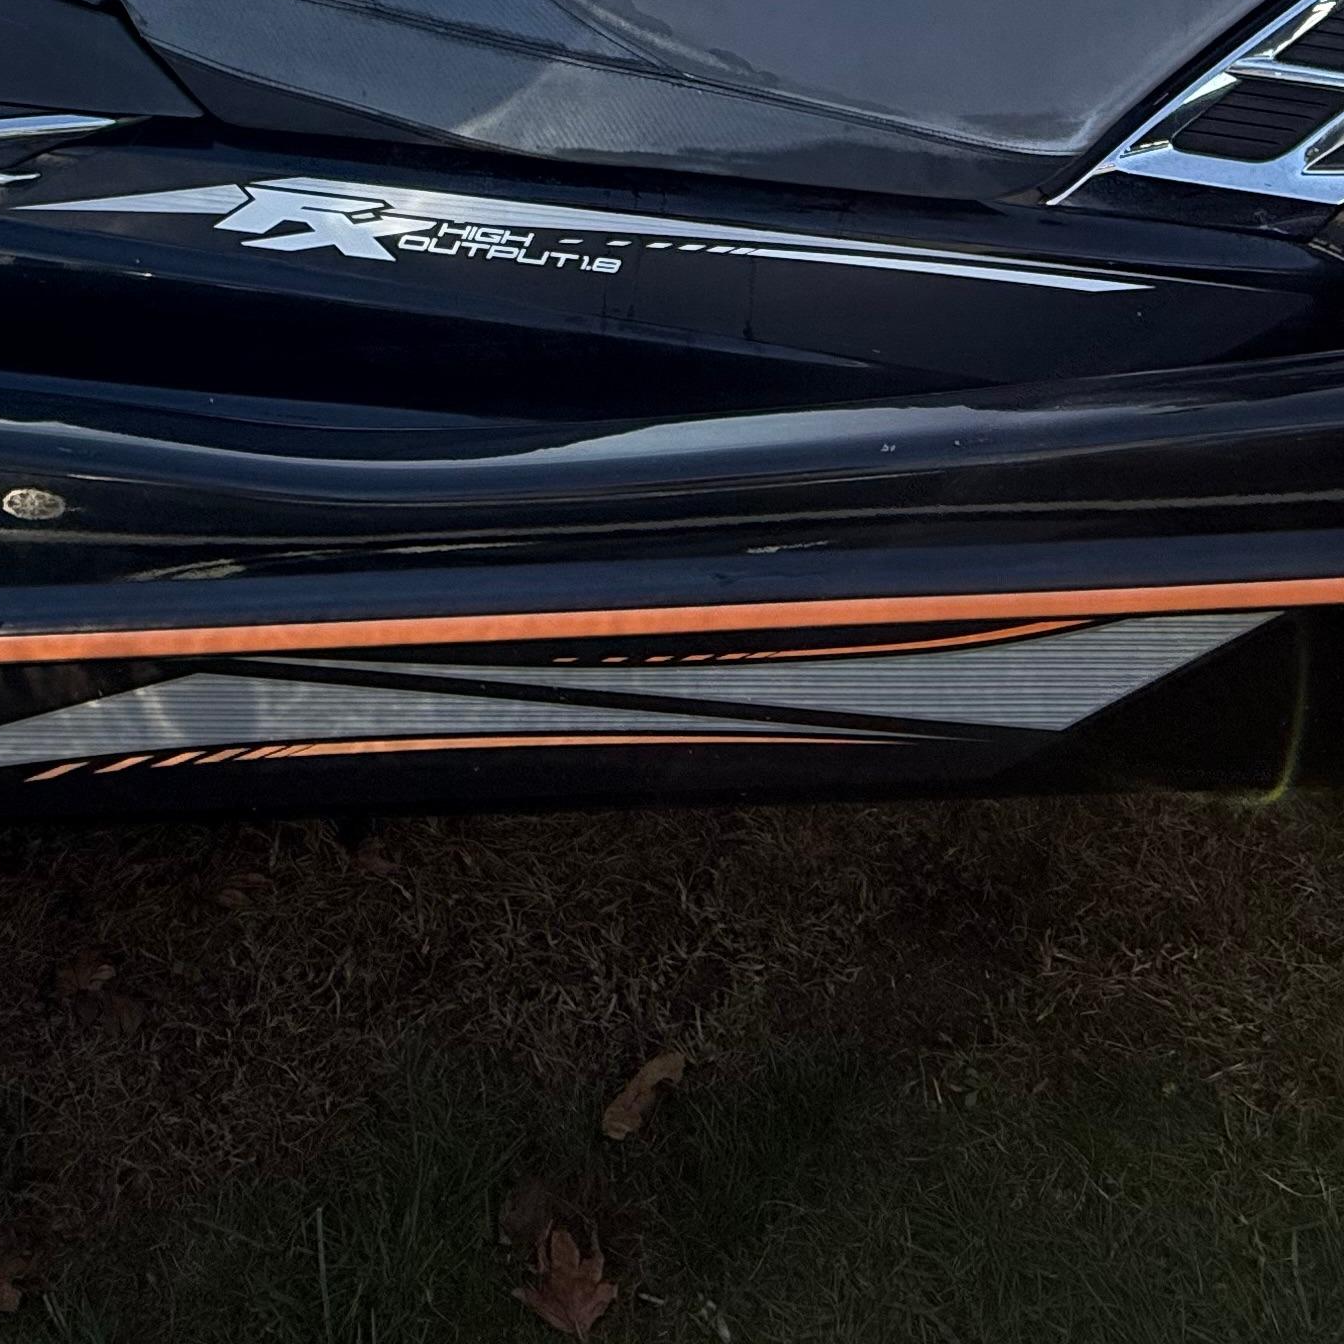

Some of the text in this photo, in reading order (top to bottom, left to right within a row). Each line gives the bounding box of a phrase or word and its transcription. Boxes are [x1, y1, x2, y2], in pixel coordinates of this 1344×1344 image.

[213, 184, 438, 263] FX
[437, 222, 535, 247] HIGH
[397, 235, 623, 275] OUTPUT 1.8
